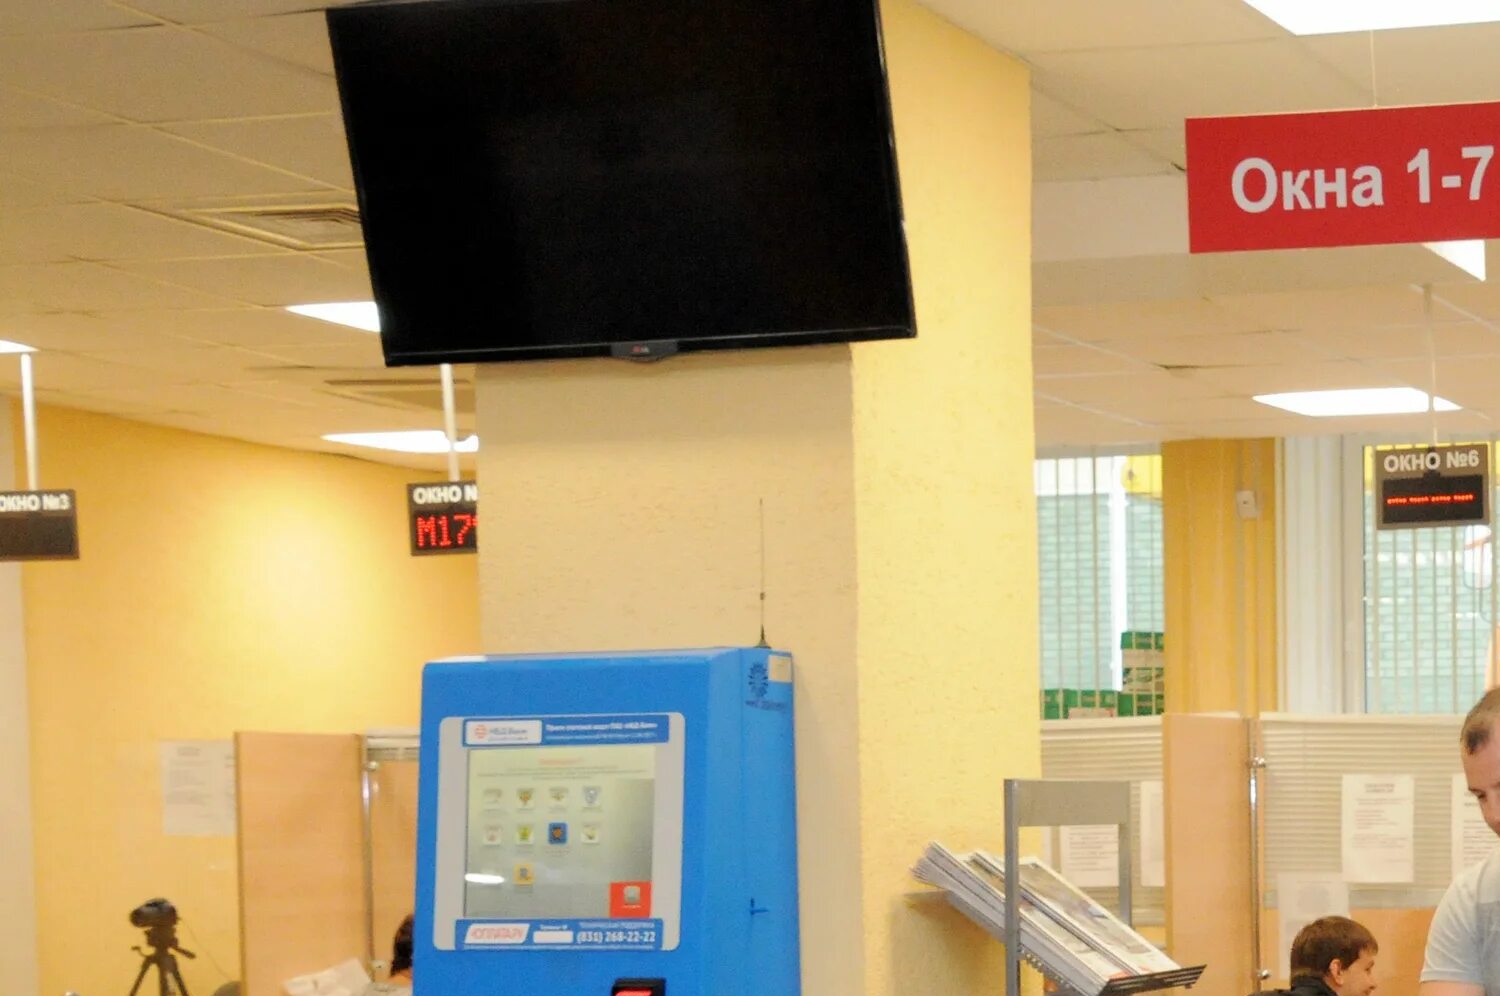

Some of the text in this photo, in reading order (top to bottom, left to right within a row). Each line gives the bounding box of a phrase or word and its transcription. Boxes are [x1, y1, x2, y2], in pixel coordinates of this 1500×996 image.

[1232, 146, 1494, 213] Окна 1-7
[1384, 450, 1479, 472] ОКНО №6
[413, 485, 462, 504] ОКНО
[417, 514, 478, 546] М17
